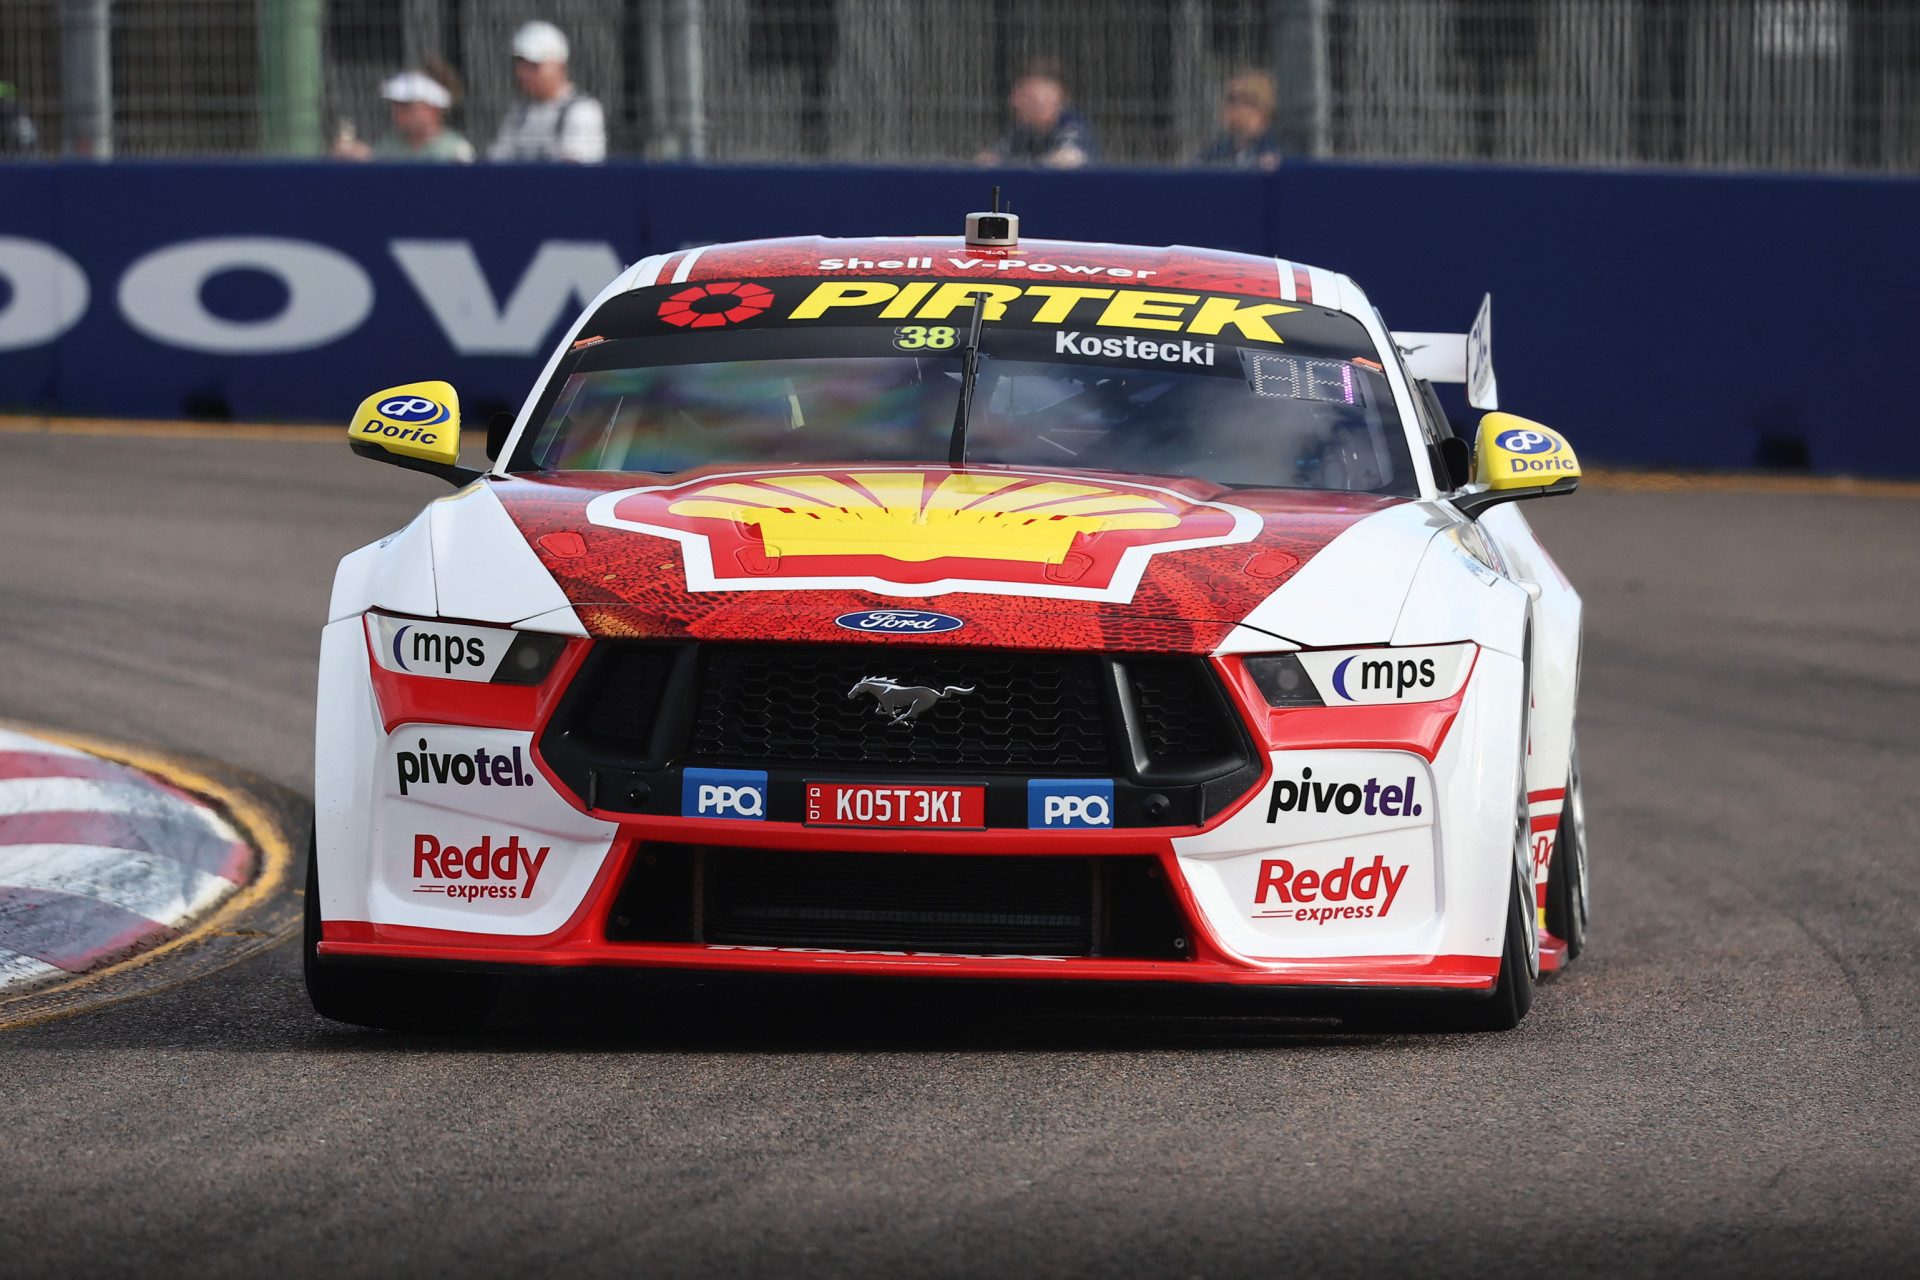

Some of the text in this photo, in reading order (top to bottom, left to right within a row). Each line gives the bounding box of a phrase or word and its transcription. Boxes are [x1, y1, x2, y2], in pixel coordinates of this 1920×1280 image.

[818, 257, 1157, 279] Shell V-Power
[787, 281, 1304, 344] PIRTEK
[898, 325, 956, 349] 38
[1055, 330, 1215, 367] Kostecki
[362, 419, 438, 445] Doric
[1510, 457, 1575, 473] Doric
[859, 611, 939, 630] Ford
[412, 631, 486, 674] mps
[1360, 658, 1436, 699] mps
[396, 737, 534, 796] pivotel.
[698, 784, 764, 817] PPQ
[1045, 795, 1111, 826] PPQ
[1266, 766, 1423, 824] pivotel.
[412, 833, 551, 899] Reddy
[446, 883, 517, 903] express
[1254, 855, 1410, 917] Reddy
[1294, 904, 1375, 926] express
